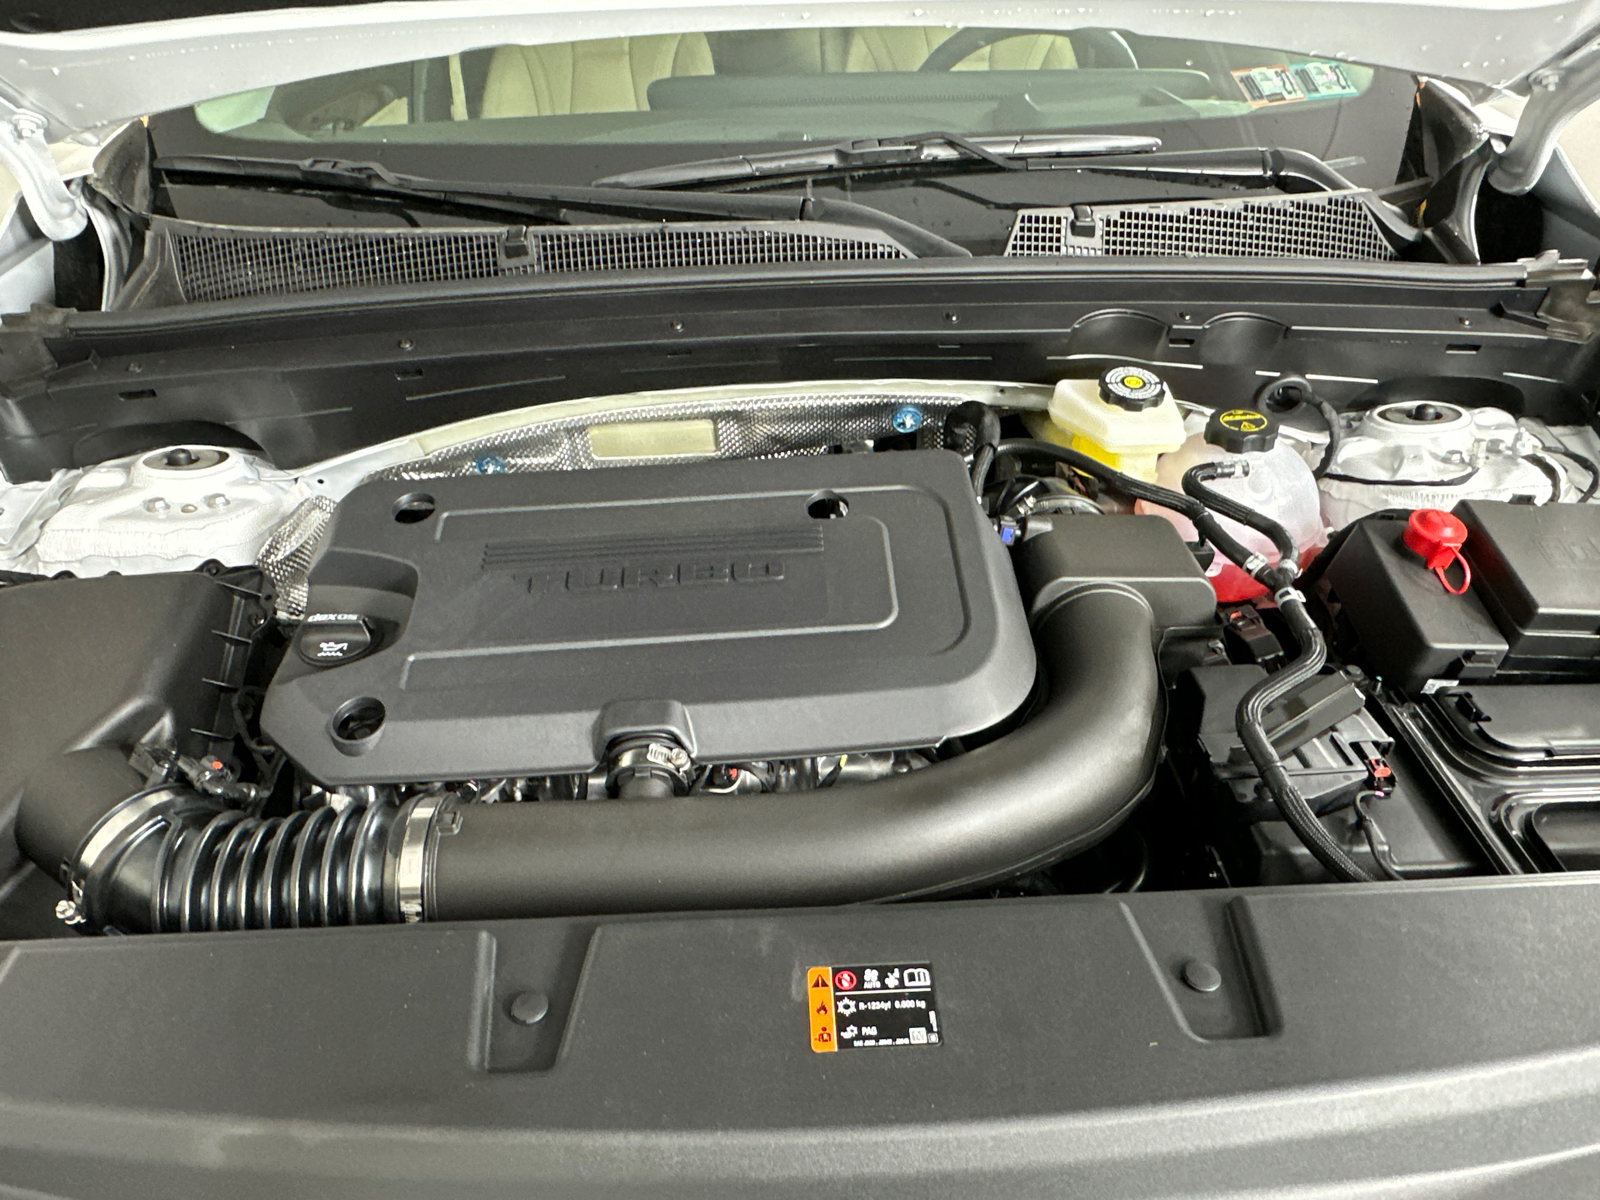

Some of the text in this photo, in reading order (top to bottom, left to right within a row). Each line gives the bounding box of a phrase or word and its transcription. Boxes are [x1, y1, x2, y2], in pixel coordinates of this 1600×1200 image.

[513, 562, 785, 593] TURBO
[863, 981, 881, 989] AUTO
[916, 1000, 926, 1009] kg
[861, 1026, 878, 1036] PAG
